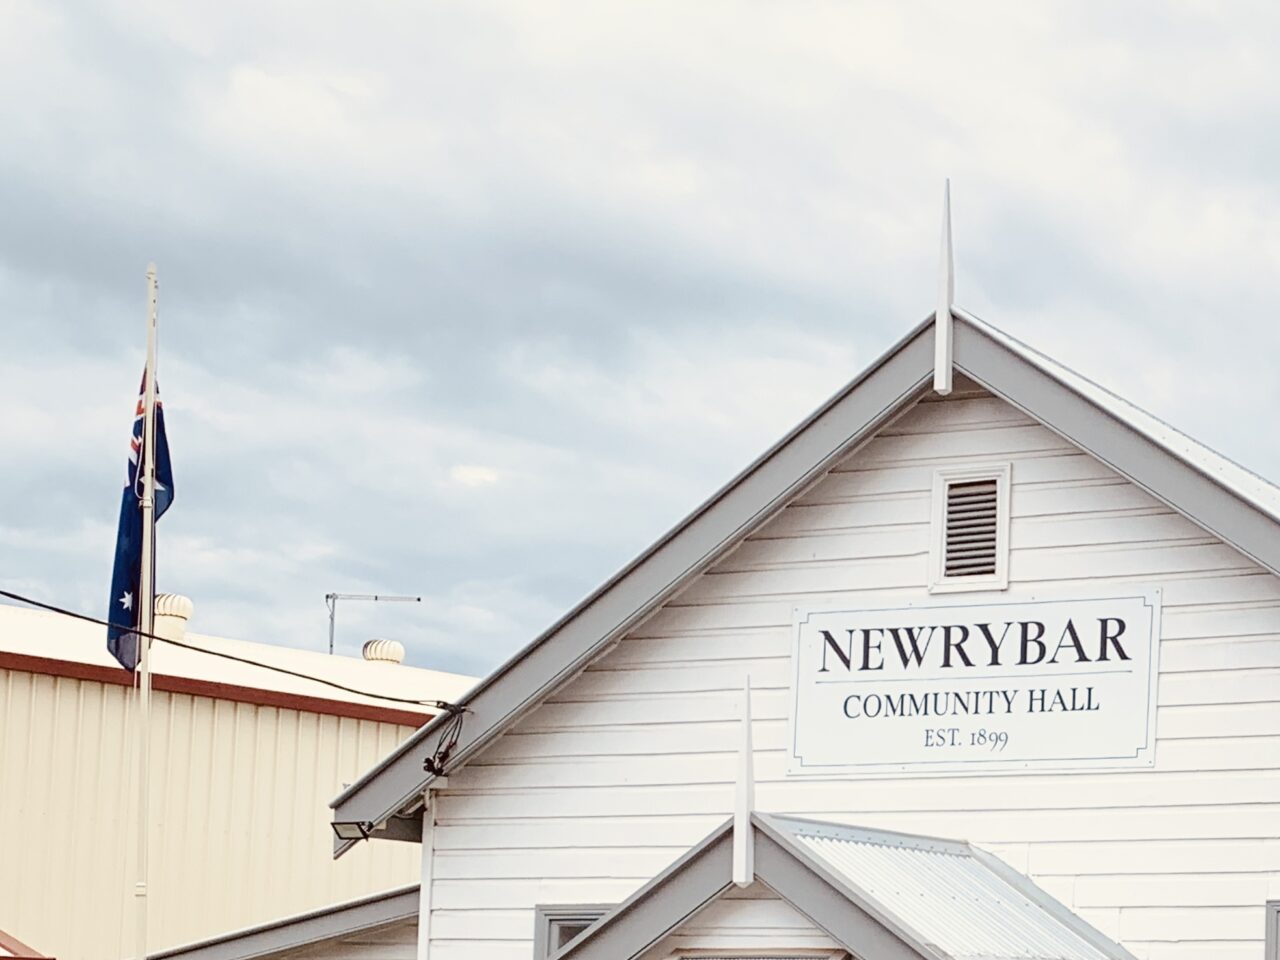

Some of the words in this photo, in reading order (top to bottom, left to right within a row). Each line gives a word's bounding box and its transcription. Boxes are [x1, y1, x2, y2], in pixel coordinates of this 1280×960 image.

[817, 617, 1133, 673] NEWRYBAR
[843, 689, 1019, 719] COMMUNITY
[1027, 687, 1101, 713] HALL
[924, 728, 962, 747] EST.
[970, 731, 1009, 752] 1899
